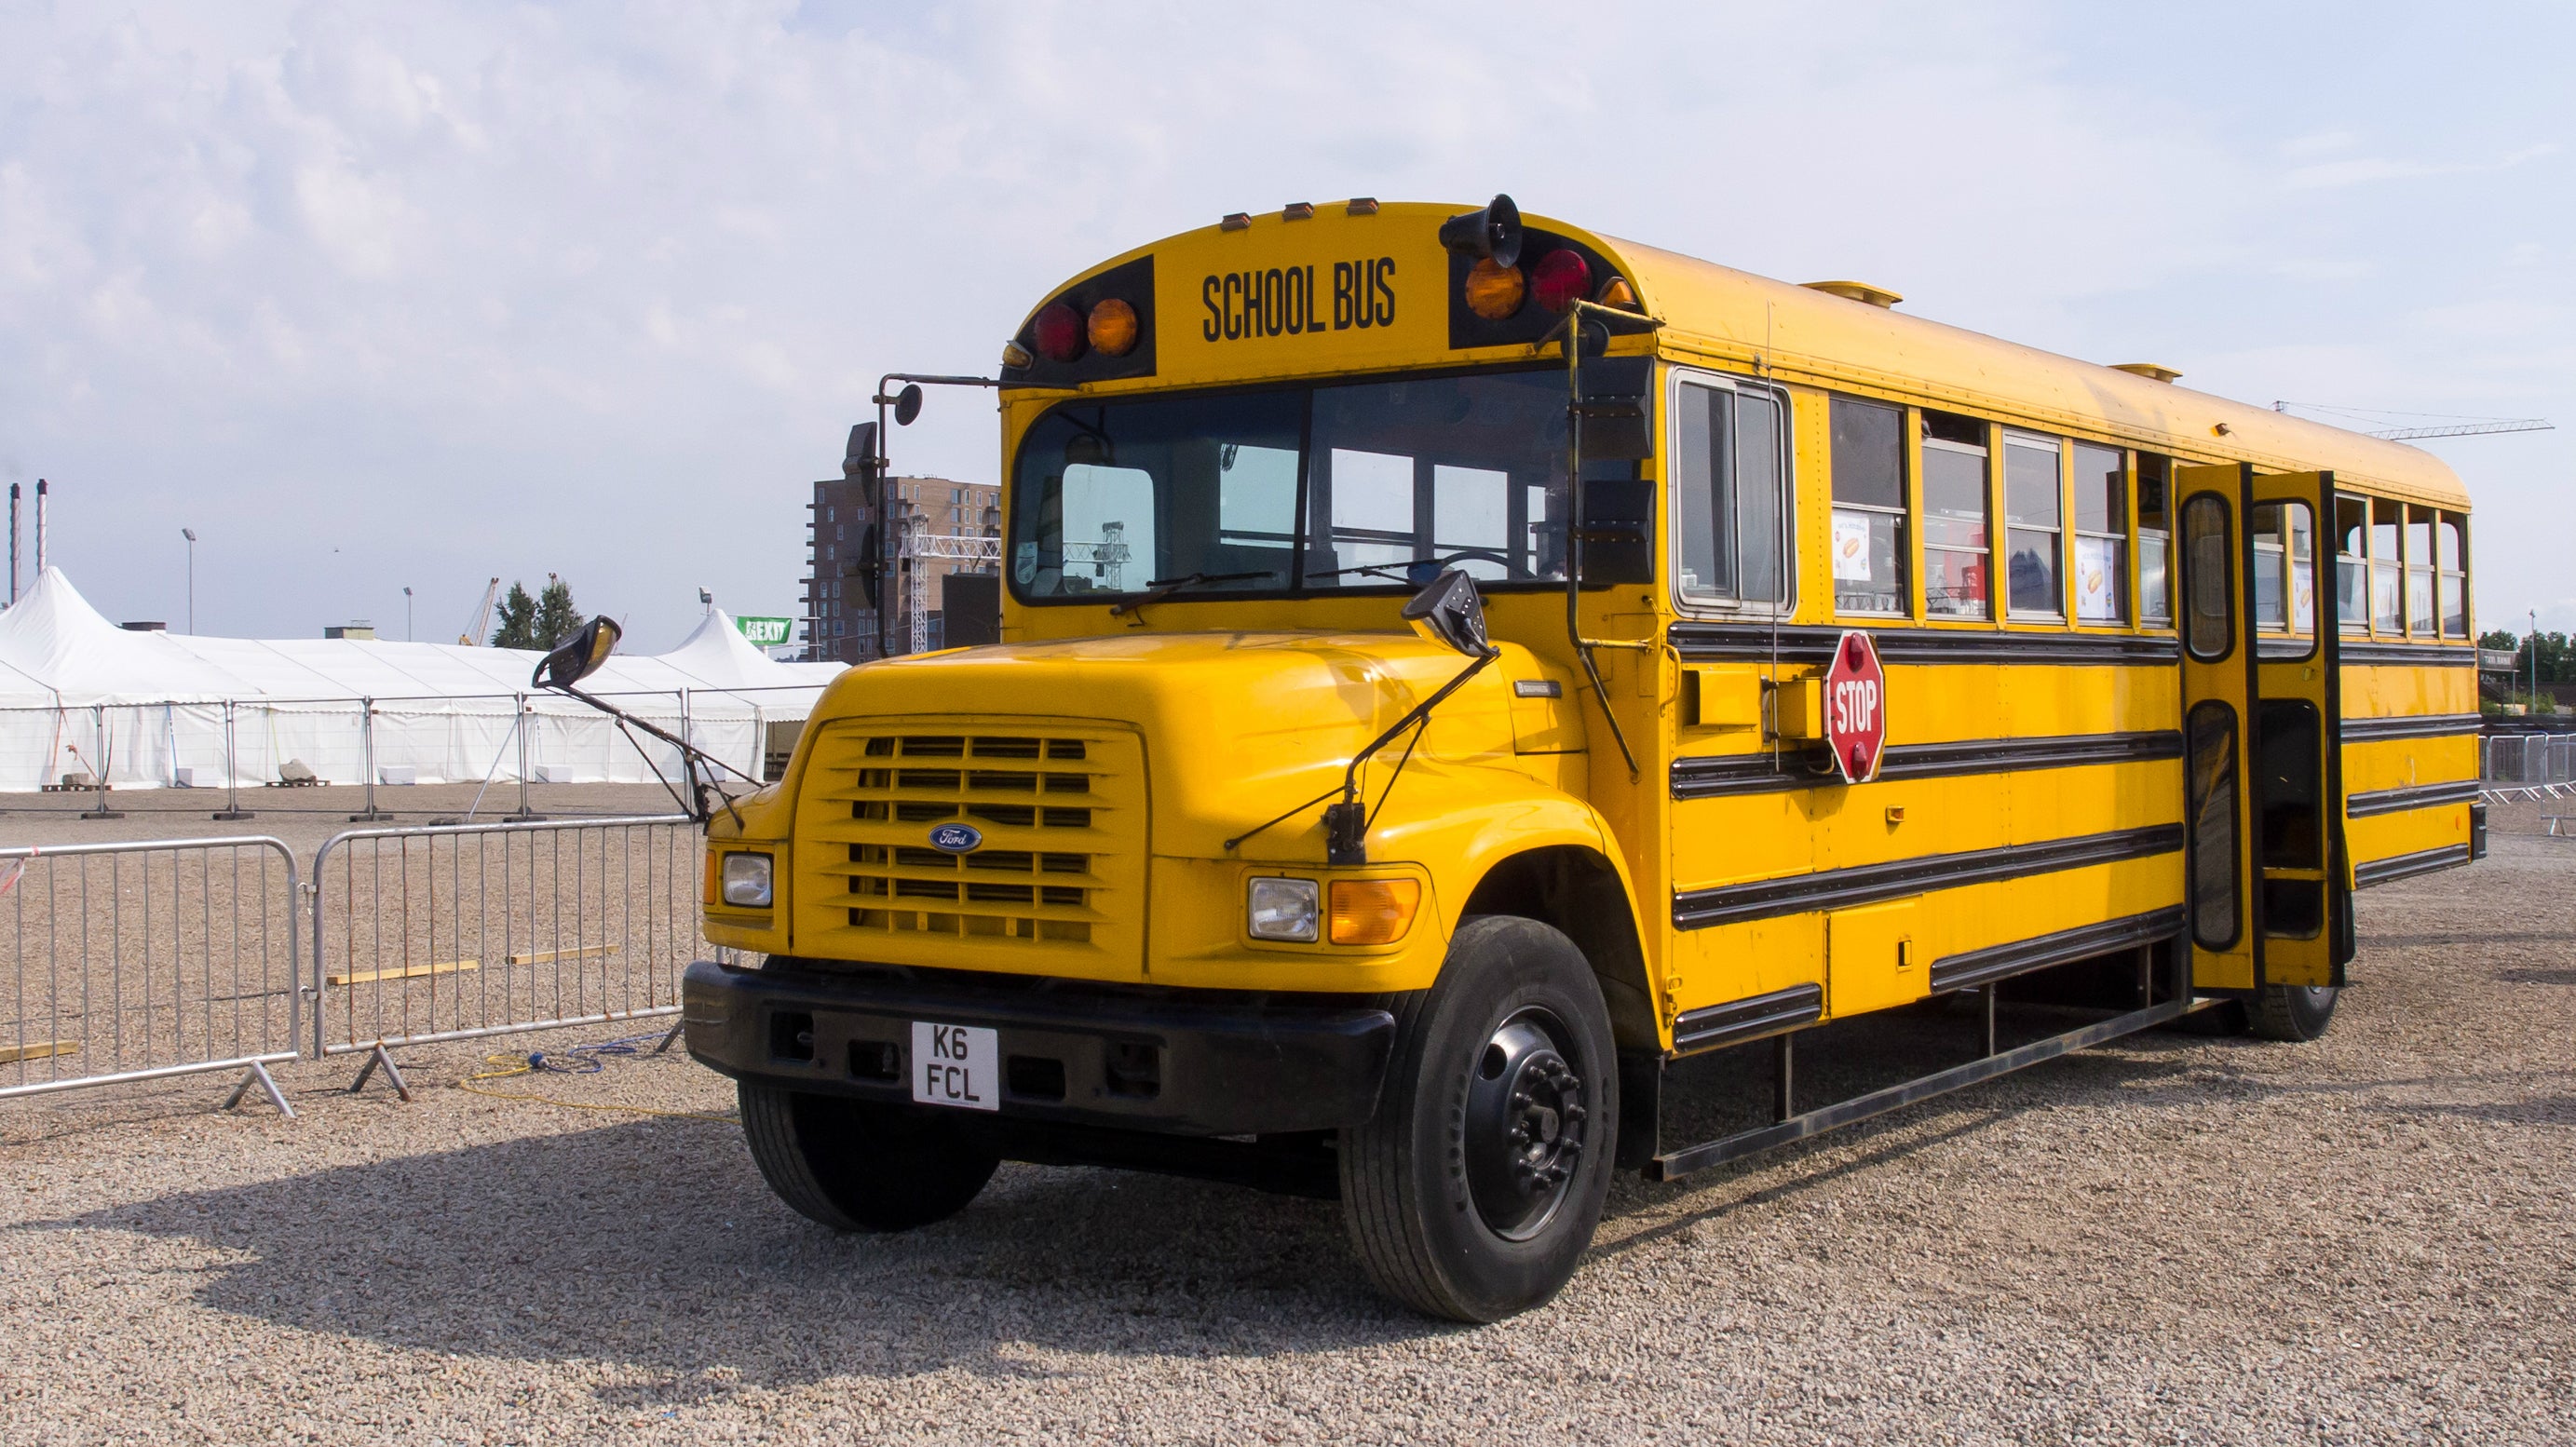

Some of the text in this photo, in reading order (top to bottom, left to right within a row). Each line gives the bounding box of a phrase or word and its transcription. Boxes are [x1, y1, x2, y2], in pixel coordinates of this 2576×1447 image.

[1202, 256, 1396, 343] SCHOOL BUS
[758, 620, 786, 642] EXIT
[1836, 679, 1878, 735] STOP
[939, 829, 967, 845] Ford
[933, 1024, 968, 1061] K6
[927, 1063, 981, 1102] FCL
